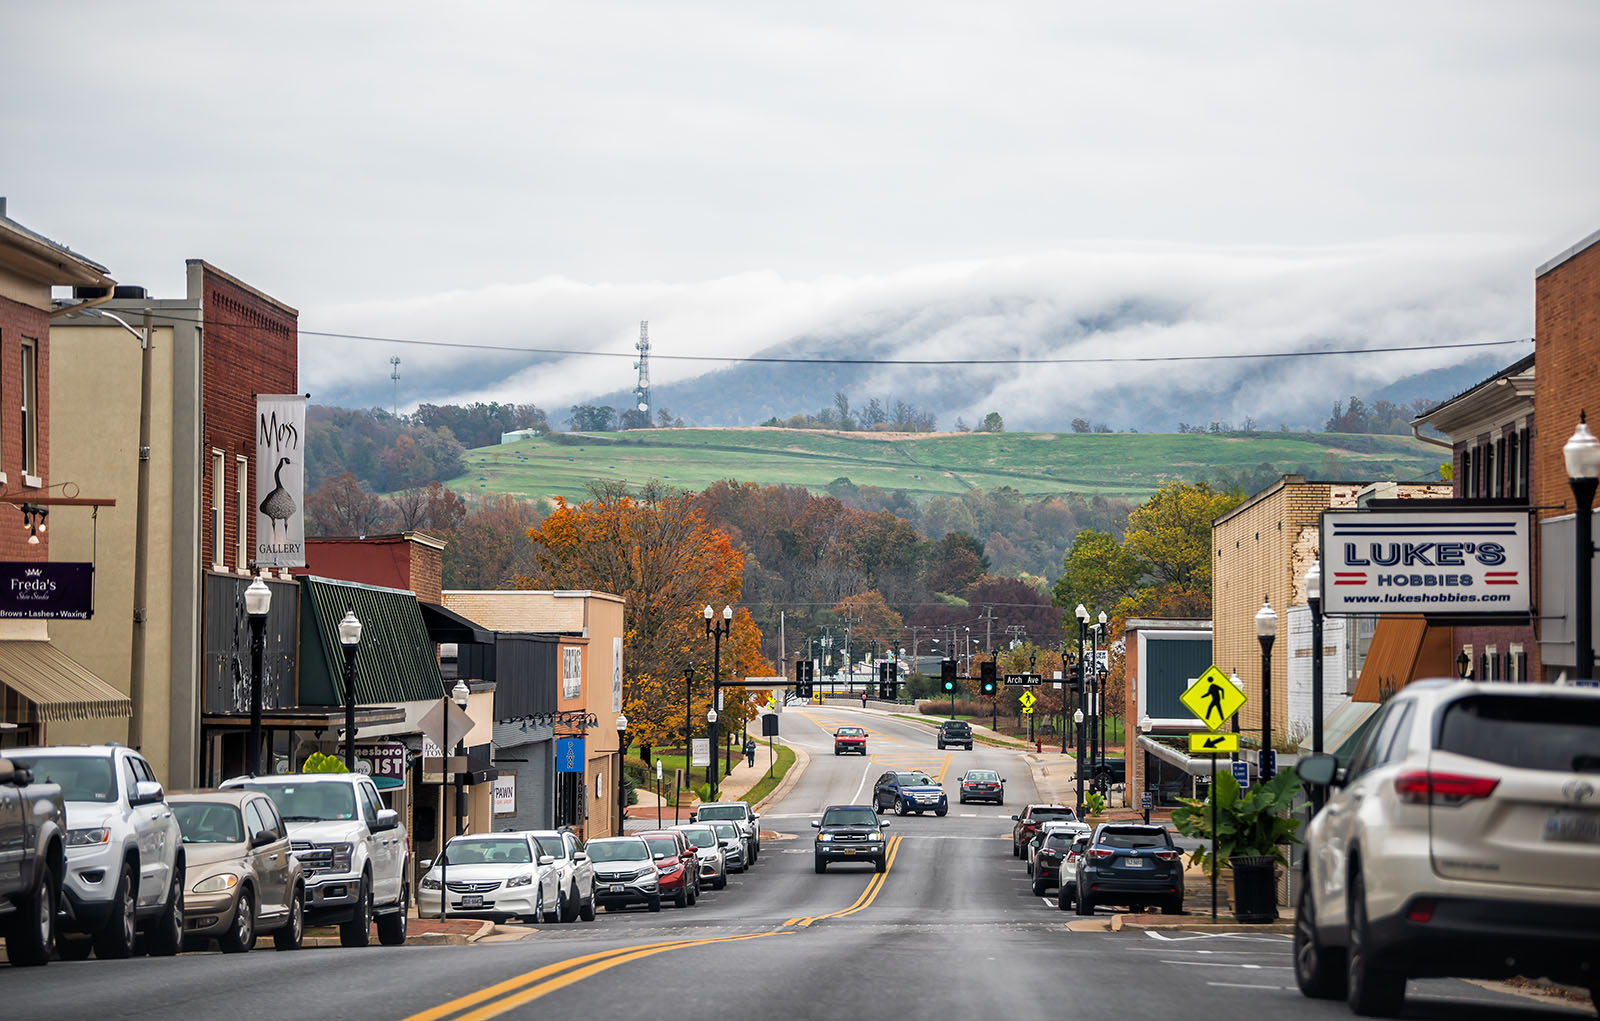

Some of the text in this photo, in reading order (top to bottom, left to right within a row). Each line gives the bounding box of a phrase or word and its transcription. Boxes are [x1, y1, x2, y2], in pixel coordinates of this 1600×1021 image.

[259, 411, 298, 452] Moss
[259, 543, 301, 554] GALLERY
[1344, 542, 1506, 566] LUKE'S
[11, 579, 56, 590] Freda's
[1377, 574, 1473, 586] HOBBIES
[1344, 593, 1511, 603] www.lukeshobbies.com
[60, 610, 87, 619] Waxing
[1007, 676, 1039, 684] Arch Ave
[566, 742, 575, 769] PAWN
[495, 787, 513, 799] PAWN
